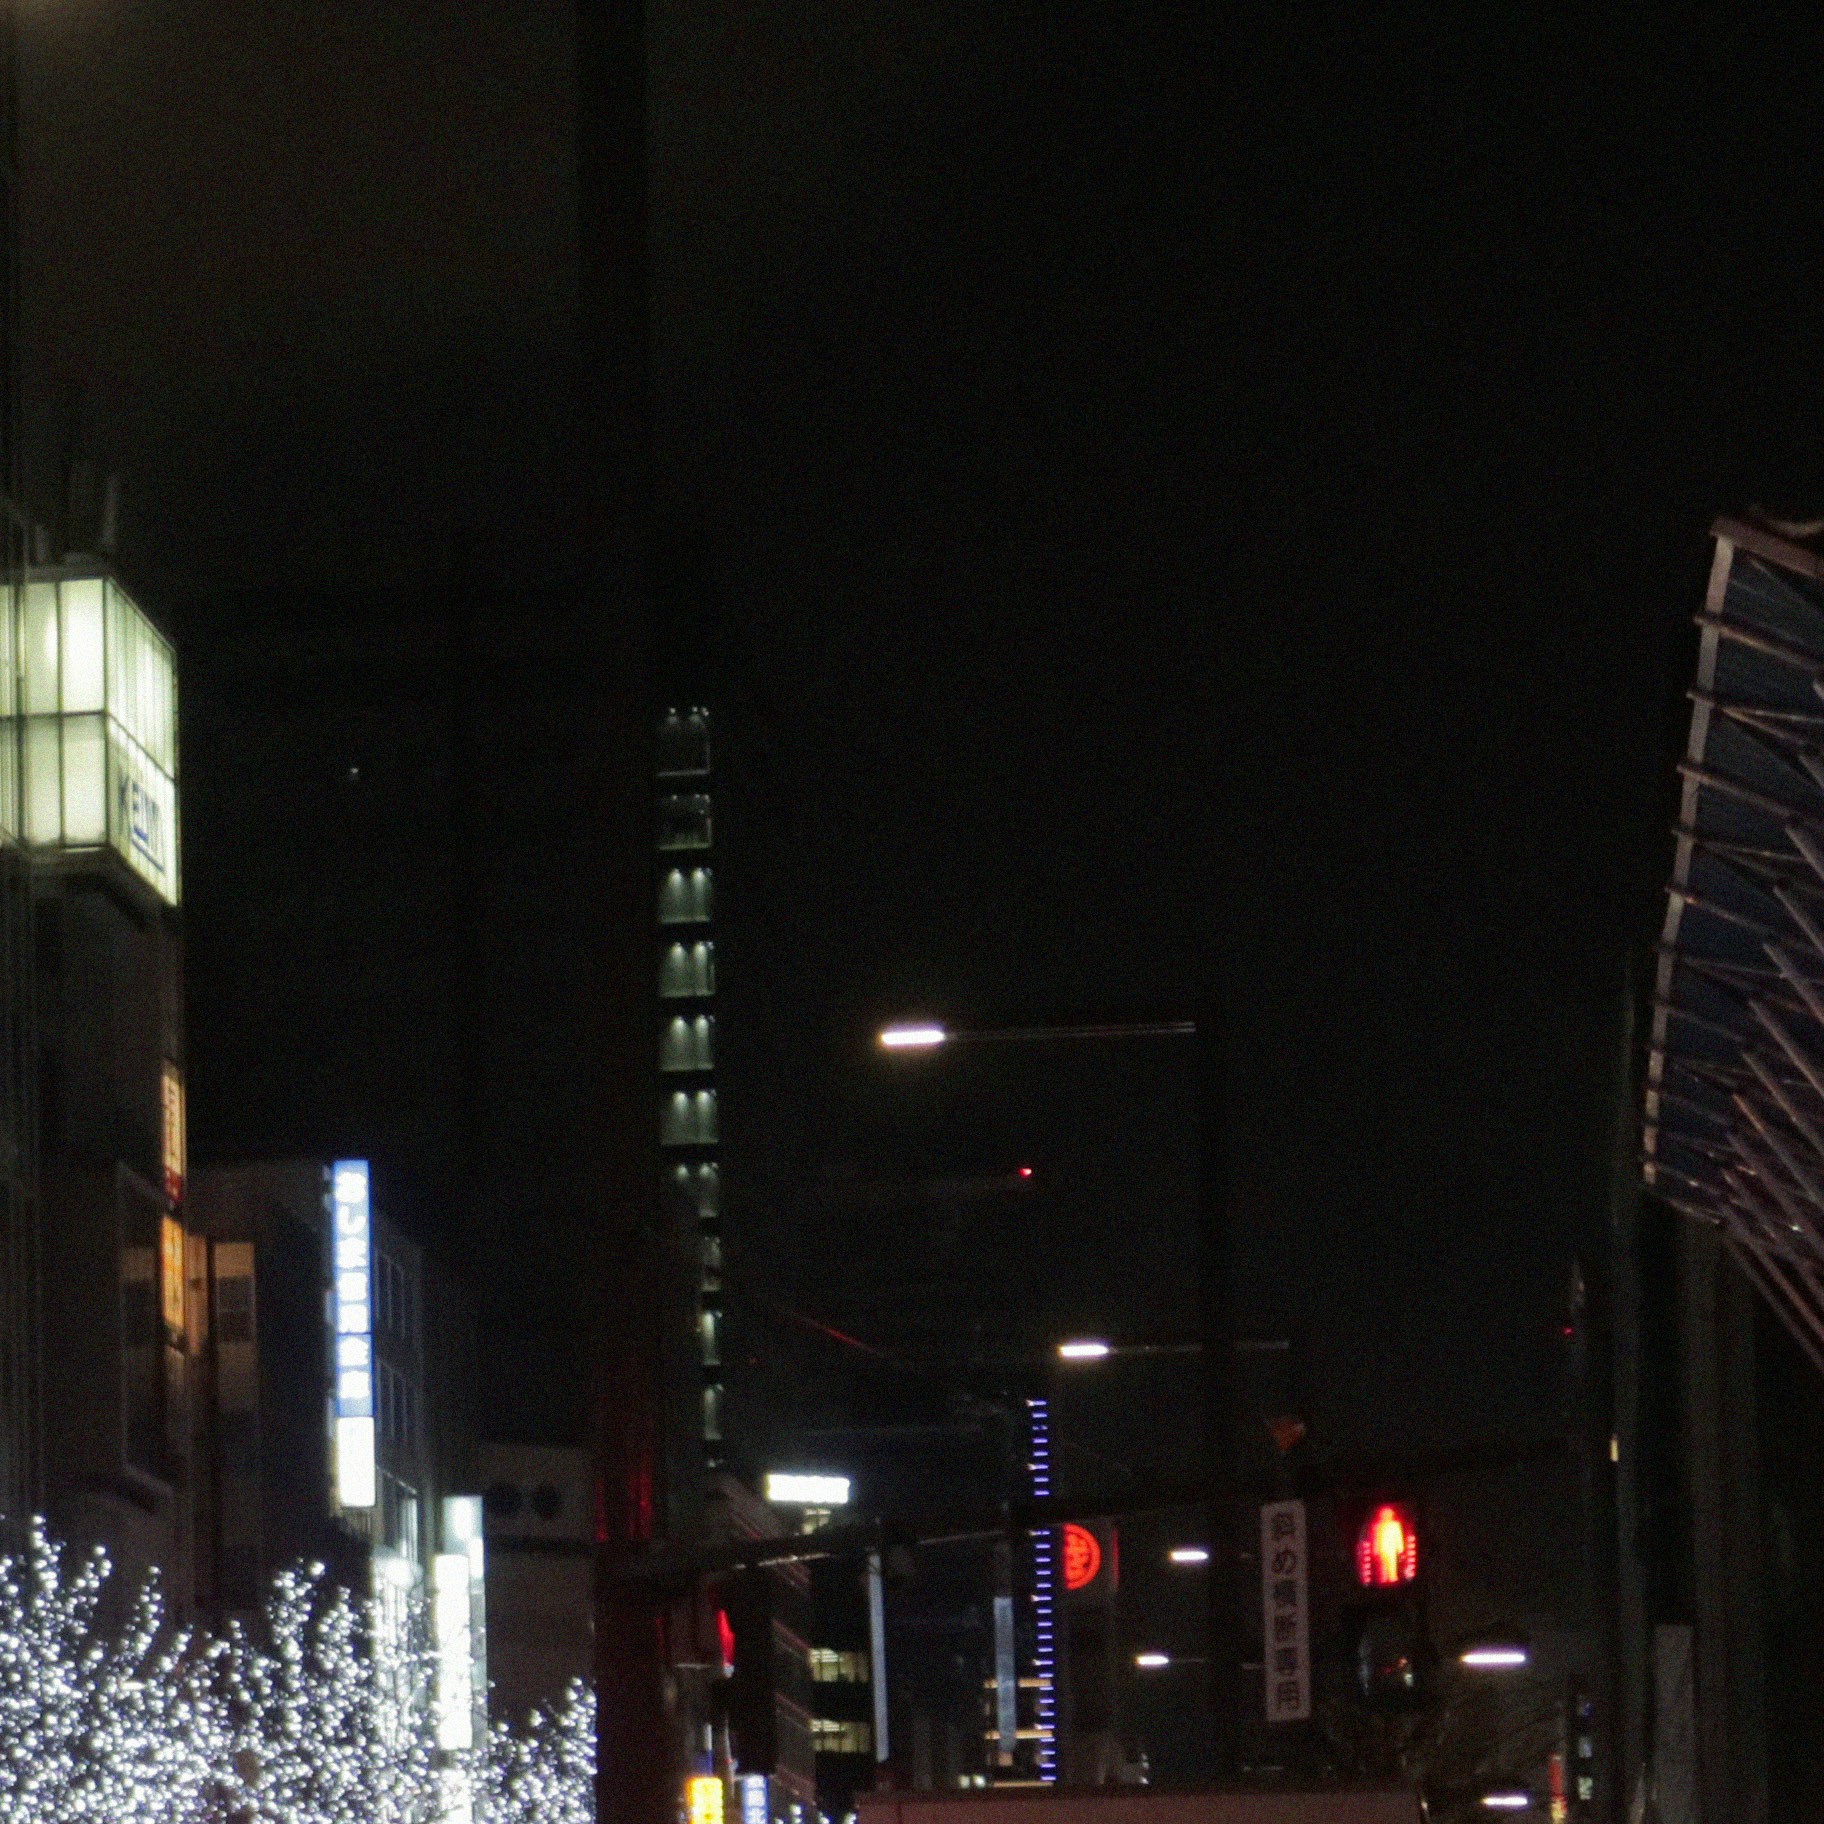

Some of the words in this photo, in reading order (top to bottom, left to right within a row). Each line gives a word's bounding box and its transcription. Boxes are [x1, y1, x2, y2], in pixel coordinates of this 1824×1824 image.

[1272, 1512, 1300, 1711] 斜め横断専用
